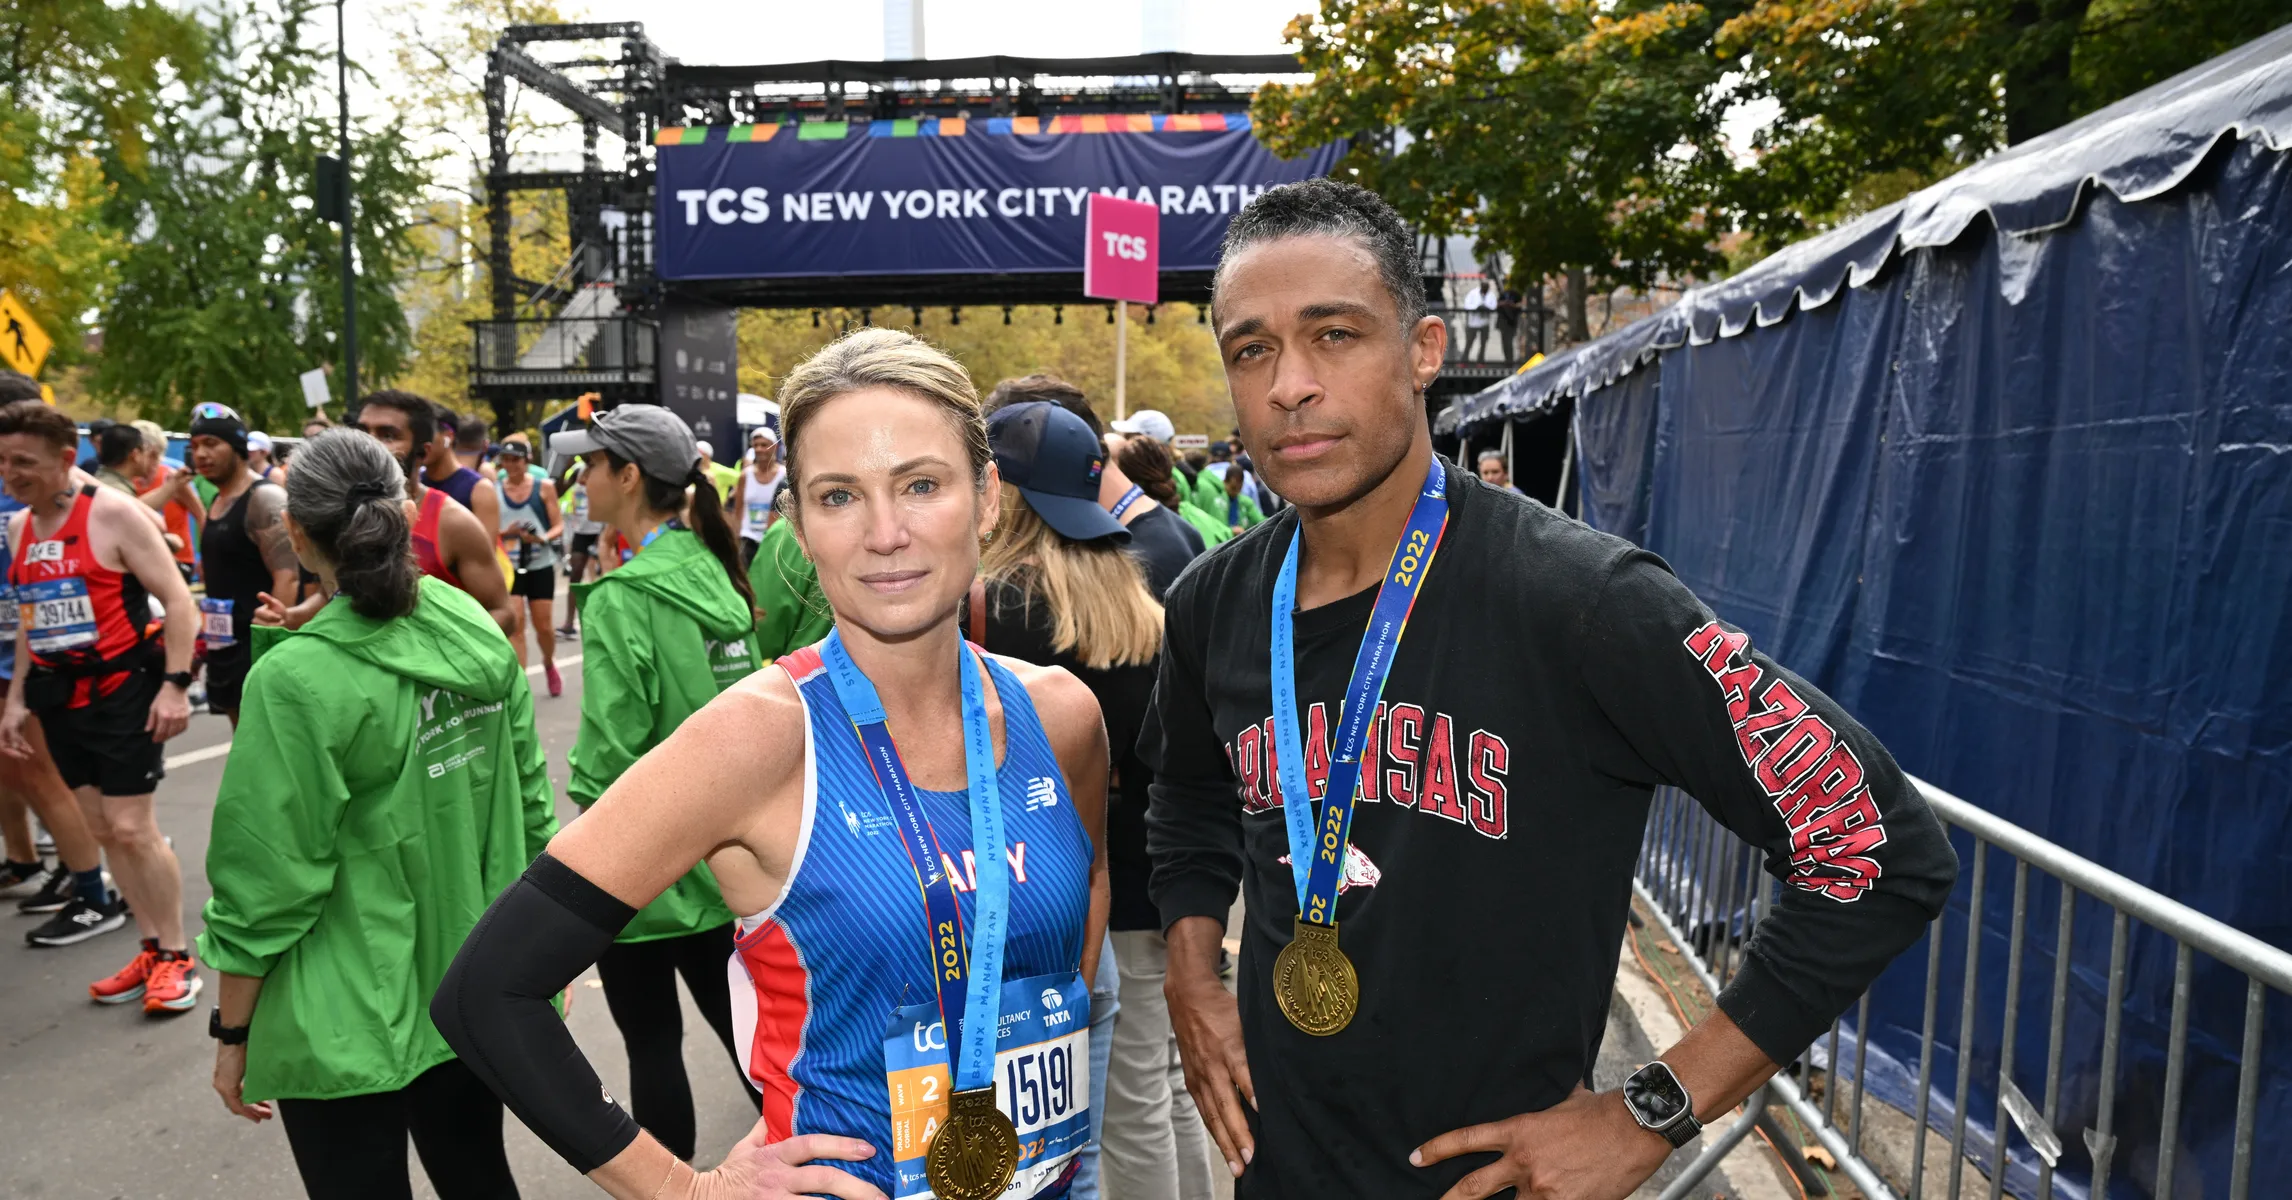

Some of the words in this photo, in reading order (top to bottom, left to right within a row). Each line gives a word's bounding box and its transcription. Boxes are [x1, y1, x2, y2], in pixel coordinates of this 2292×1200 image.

[676, 186, 770, 226] TCS
[782, 190, 874, 223] NEW
[880, 188, 989, 219] YORK
[997, 186, 1089, 218] CITY
[1103, 230, 1147, 262] TCS
[1395, 529, 1430, 587] 2022
[1278, 593, 1288, 670] BROOKLYN
[829, 639, 855, 687] STATEN
[1351, 715, 1361, 736] NEW
[1356, 691, 1368, 715] YORK
[1363, 670, 1375, 691] CITY
[1371, 621, 1392, 670] MARATHON
[969, 680, 979, 705] THE
[464, 701, 503, 719] RUNNER
[1280, 688, 1290, 746] QUEENS
[973, 710, 984, 757] BRONX
[879, 746, 903, 791] MARATHON
[1287, 765, 1297, 793] THE
[899, 792, 911, 811] CITY
[908, 811, 921, 834] YORK
[979, 774, 997, 862] MANHATTAN
[1292, 800, 1309, 848] BRONX
[917, 835, 930, 854] NEW
[1321, 805, 1344, 864] 2022
[938, 920, 960, 982] 2022
[1302, 929, 1330, 942] 2022
[971, 1026, 985, 1079] BRONX
[981, 911, 997, 1006] MANHATTAN
[1043, 1009, 1071, 1028] TATA
[913, 1021, 945, 1052] tc
[920, 1075, 940, 1102] 2
[1007, 1043, 1074, 1129] 15191
[958, 1097, 989, 1110] 2022
[920, 1116, 938, 1144] A
[989, 1124, 1007, 1147] NEW
[909, 1173, 920, 1182] tcs
[934, 1134, 964, 1195] MARATHON
[991, 1150, 1008, 1181] YORK
